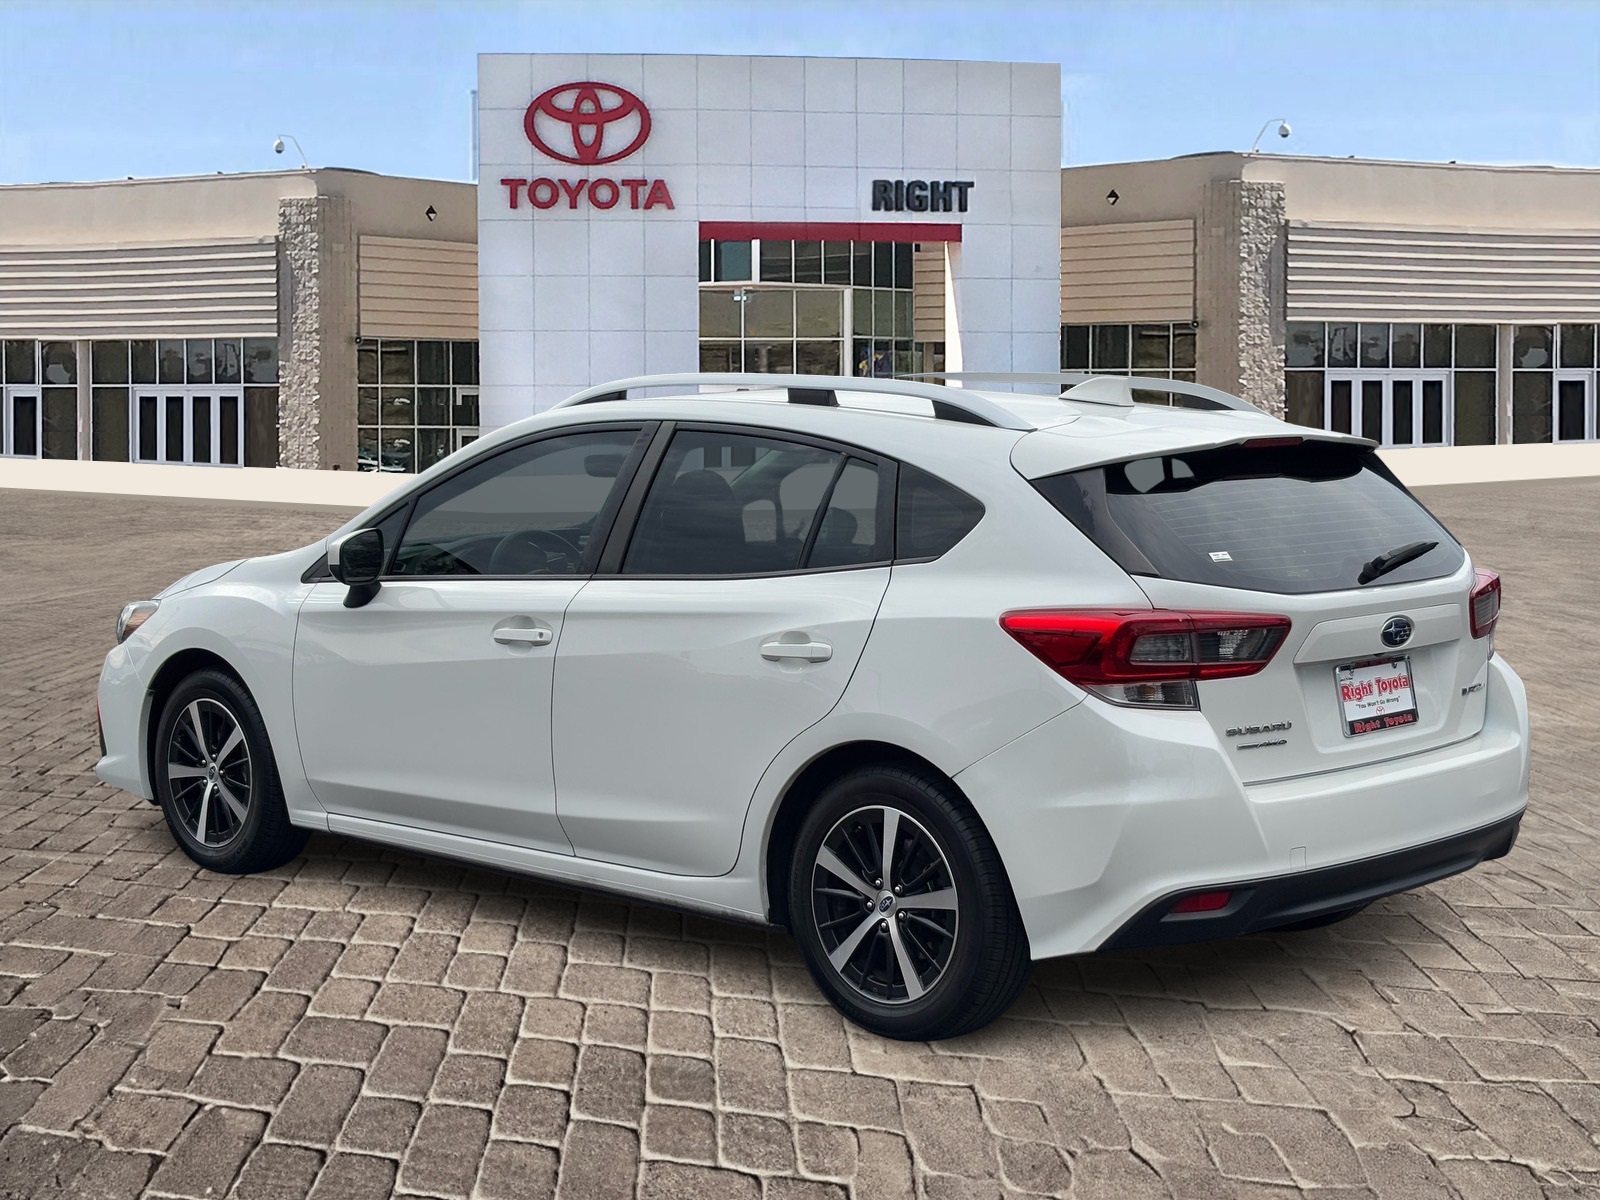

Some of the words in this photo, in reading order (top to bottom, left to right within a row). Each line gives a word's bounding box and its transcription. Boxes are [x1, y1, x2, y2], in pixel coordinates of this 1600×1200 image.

[500, 178, 675, 210] TOYOTA
[871, 179, 975, 213] RIGHT
[1341, 680, 1373, 702] Right
[1375, 674, 1410, 696] Toyota
[1225, 720, 1292, 737] SUBARU
[1354, 720, 1380, 733] Right
[1384, 713, 1413, 727] Toyota
